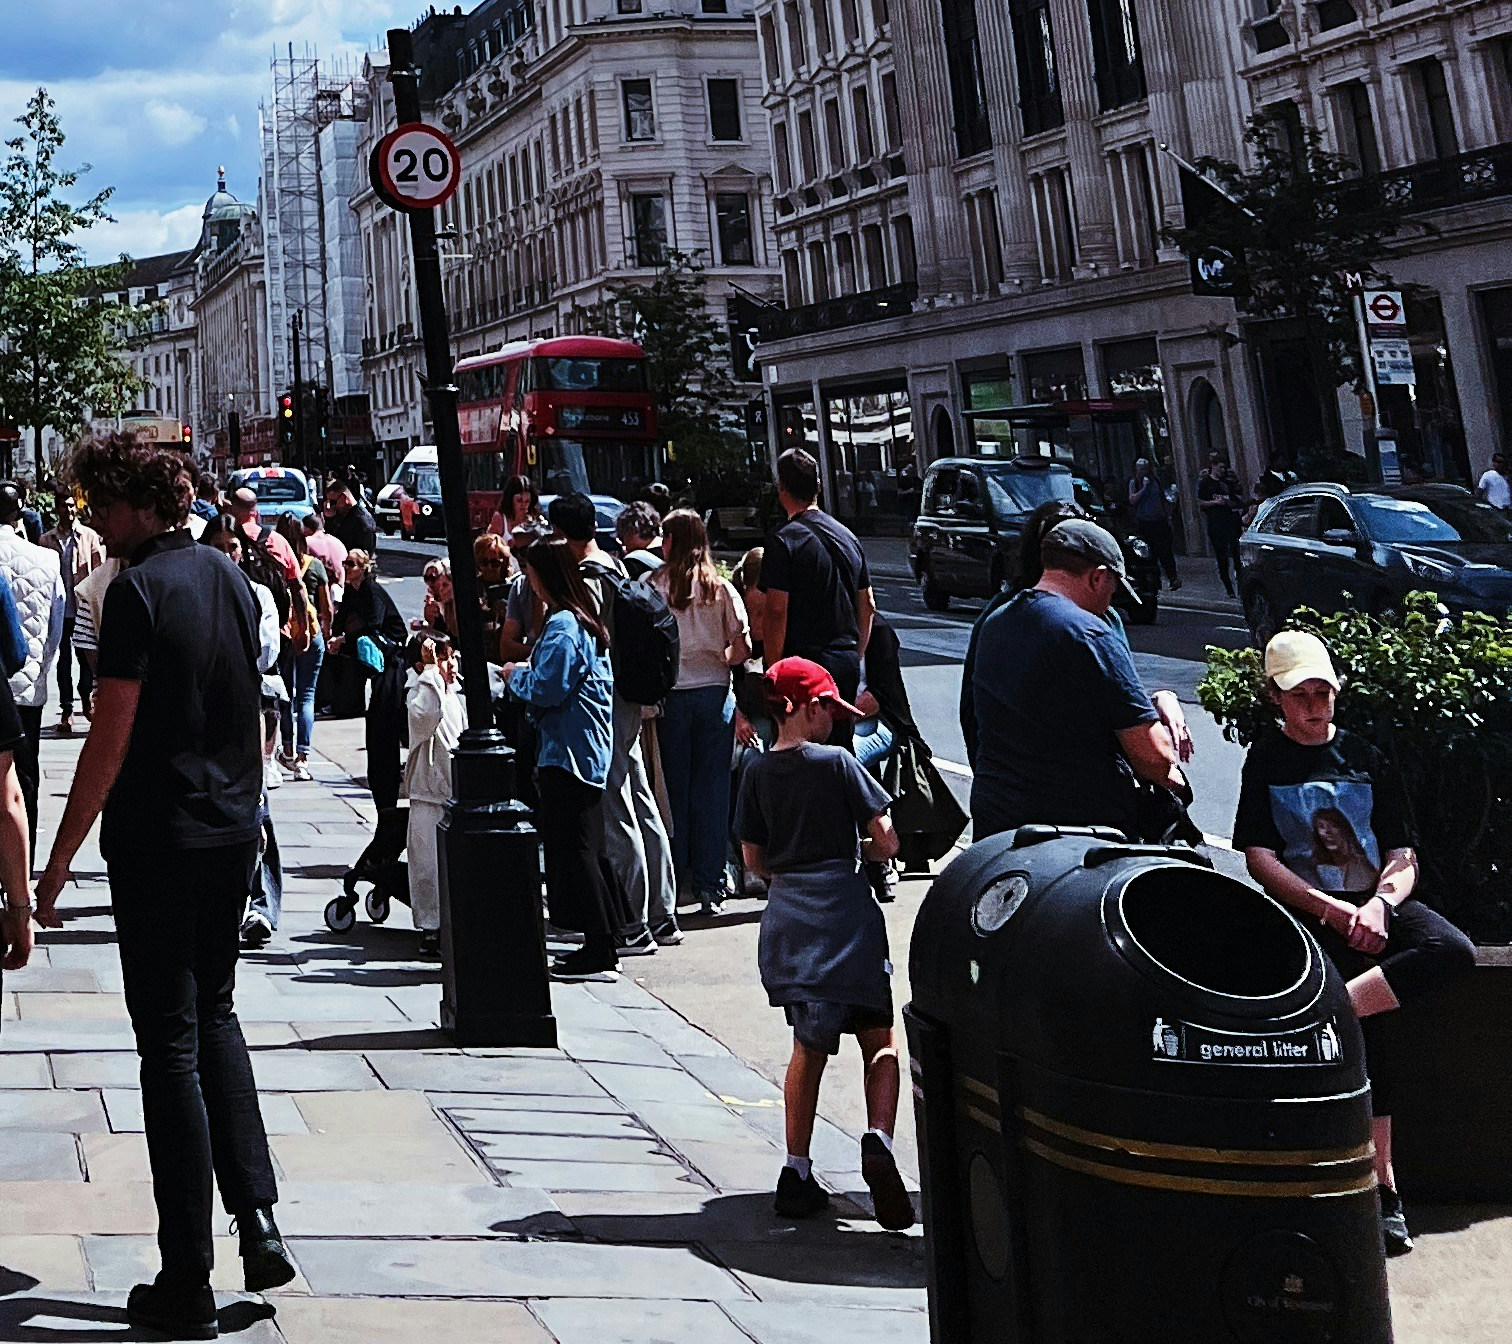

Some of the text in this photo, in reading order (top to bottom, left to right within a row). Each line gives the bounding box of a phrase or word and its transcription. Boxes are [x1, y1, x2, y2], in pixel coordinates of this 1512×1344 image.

[394, 148, 449, 182] 20
[1346, 272, 1363, 288] M
[1200, 1040, 1308, 1059] general litter
